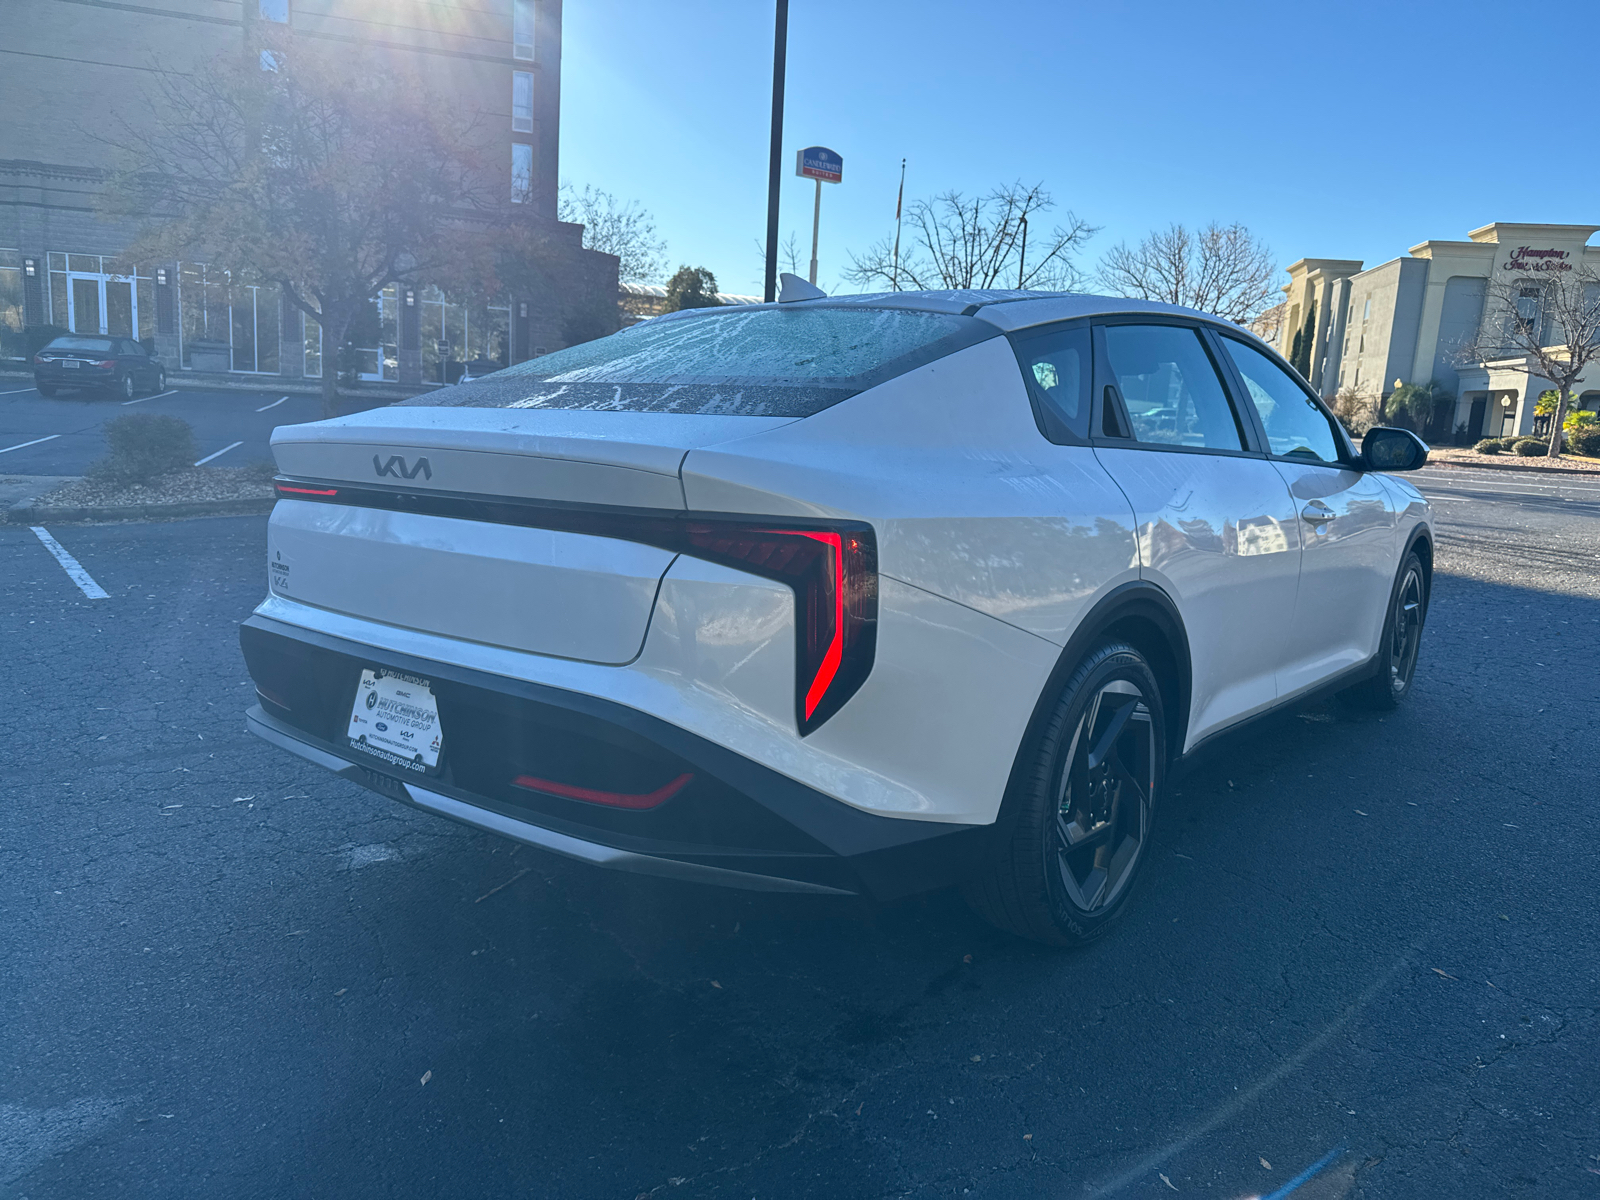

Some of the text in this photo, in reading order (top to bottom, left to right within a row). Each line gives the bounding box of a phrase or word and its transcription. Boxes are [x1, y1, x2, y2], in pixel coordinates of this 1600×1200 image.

[812, 169, 833, 178] SUITES
[1510, 246, 1570, 260] Hampton
[373, 454, 432, 480] KIA
[274, 576, 288, 589] K4
[395, 690, 411, 698] GMC
[377, 697, 437, 724] HUTCHINSON
[376, 710, 431, 731] AUTOMOTIVE GROUP
[350, 739, 426, 773] Hutchinsonautogroup.com
